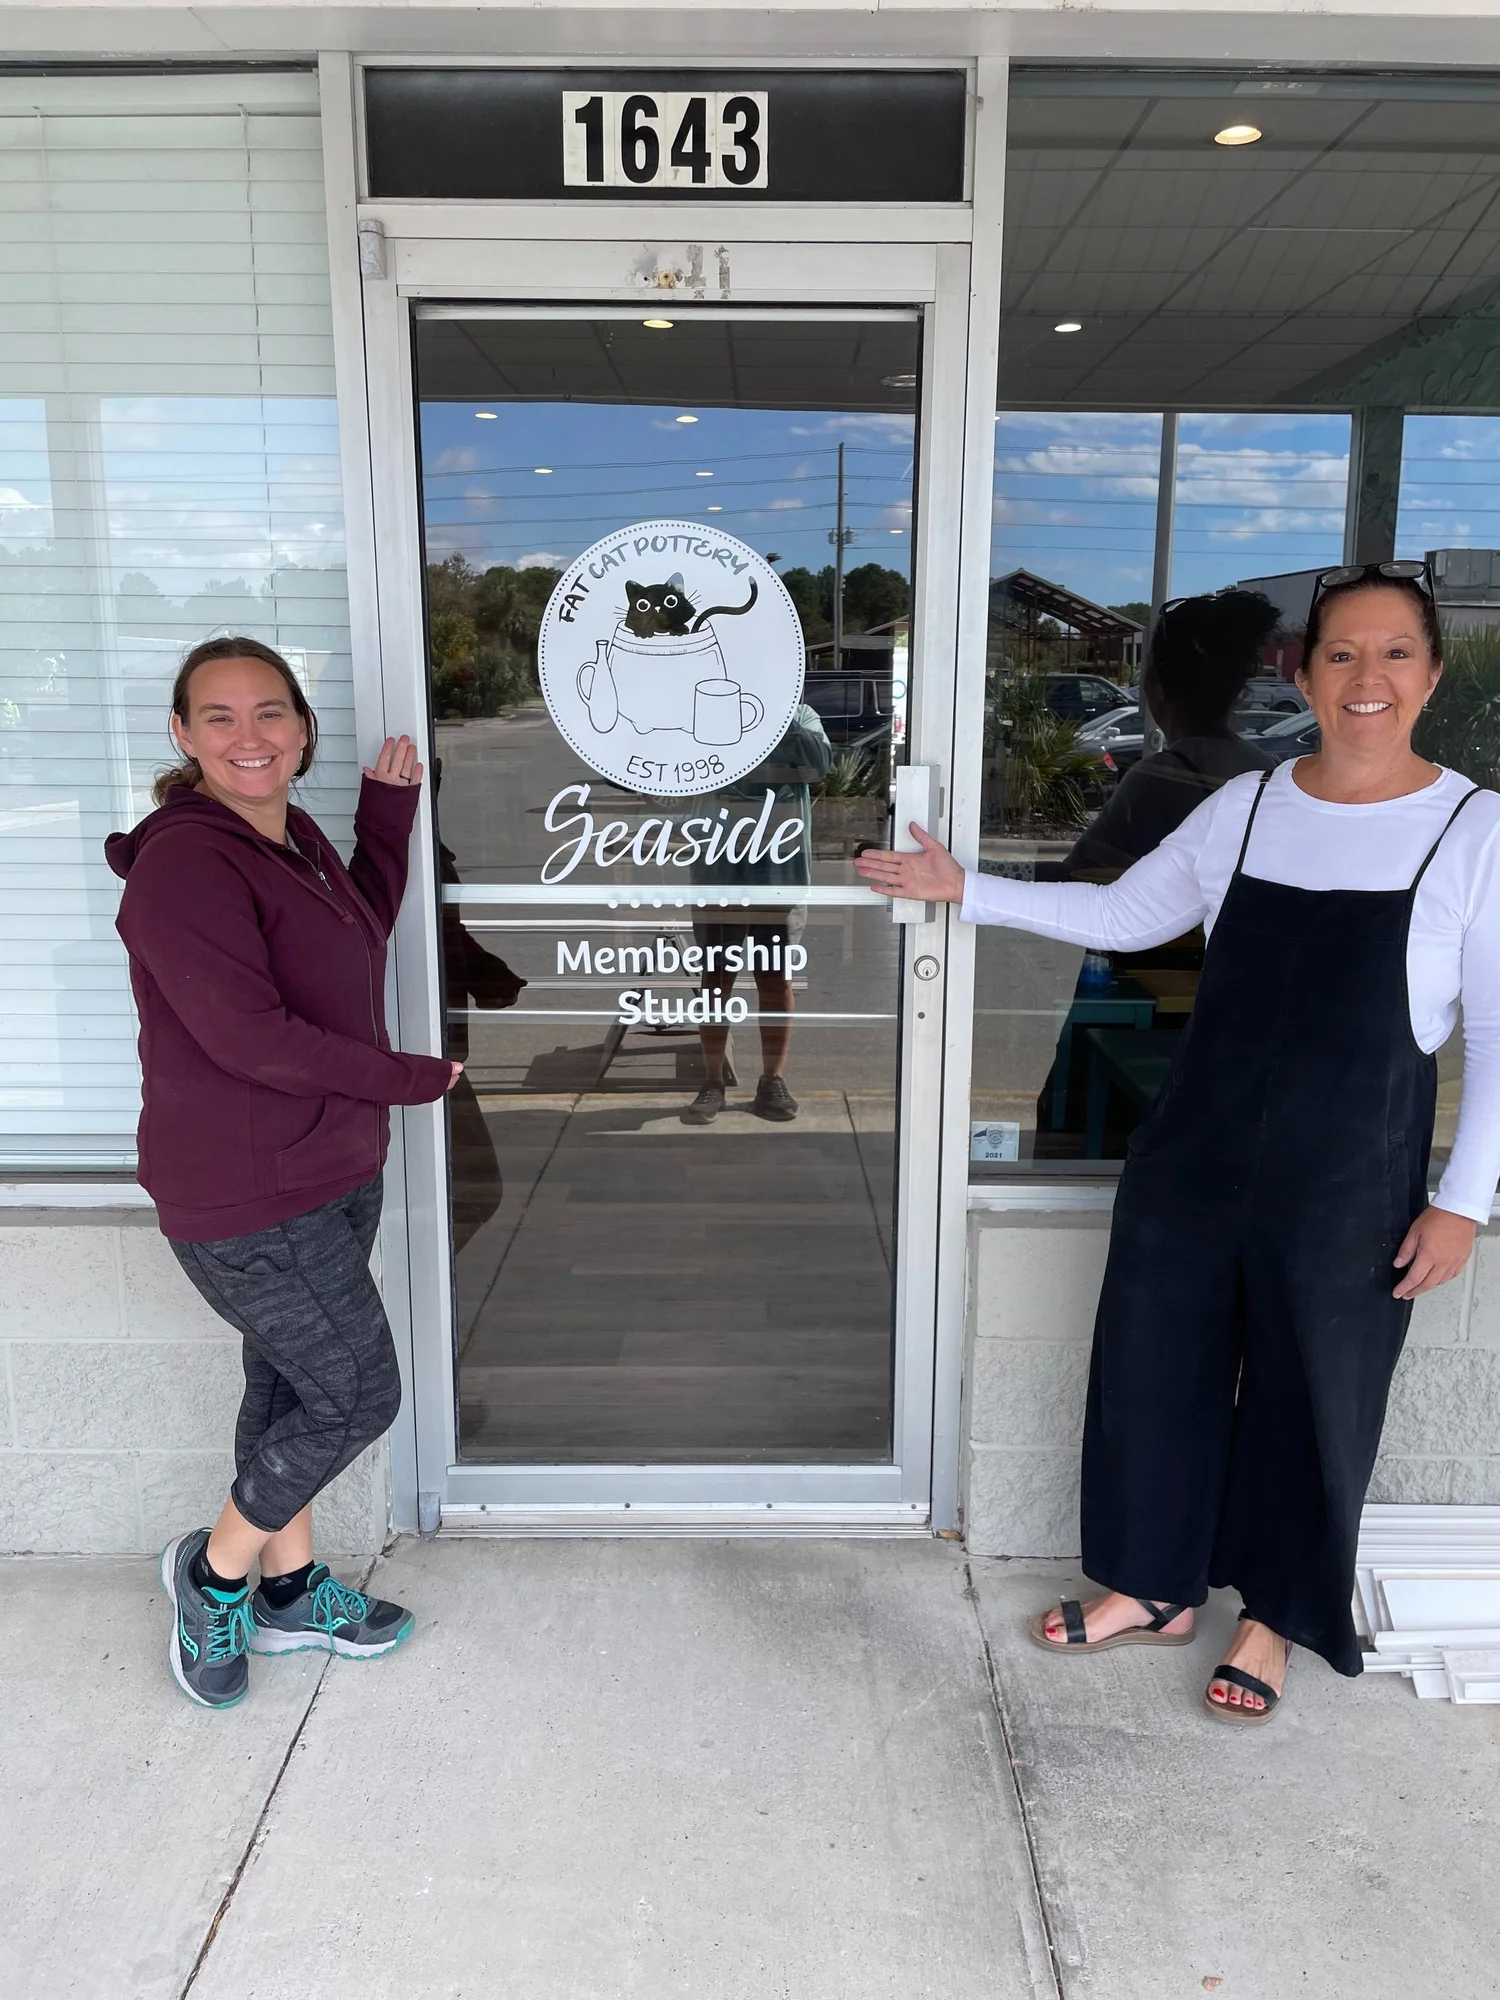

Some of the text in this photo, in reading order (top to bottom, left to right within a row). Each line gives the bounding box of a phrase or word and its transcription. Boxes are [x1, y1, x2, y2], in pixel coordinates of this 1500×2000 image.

[575, 95, 761, 184] 1643
[559, 535, 749, 623] FAT CAT POTTERY
[626, 754, 725, 784] EST 1998
[540, 783, 805, 884] Seaside
[556, 935, 808, 981] Membership
[618, 987, 749, 1025] Studio
